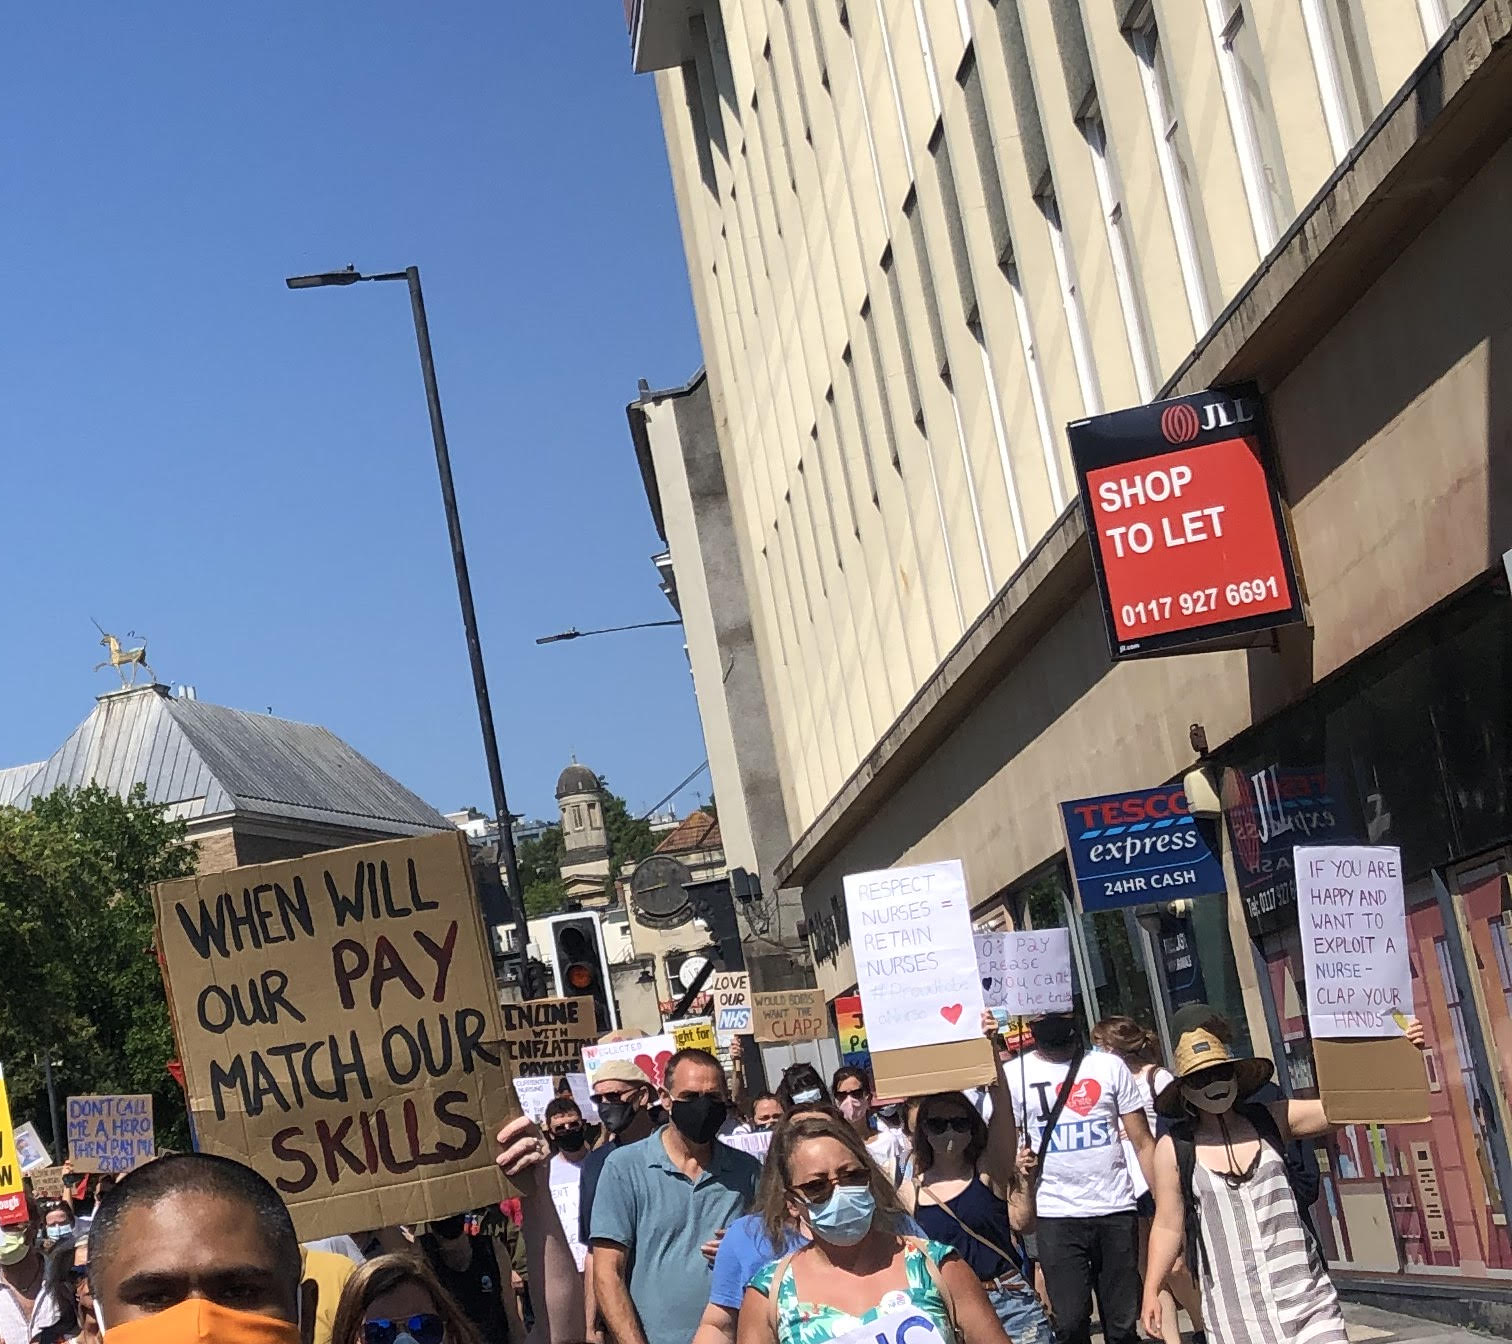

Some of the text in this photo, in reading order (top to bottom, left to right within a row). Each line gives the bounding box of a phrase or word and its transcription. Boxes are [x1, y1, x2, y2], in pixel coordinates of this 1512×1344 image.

[1202, 399, 1253, 430] JLL
[1099, 466, 1192, 512] SHOP
[1106, 506, 1225, 558] TO LET
[1122, 576, 1279, 627] 0117 927 6691
[1090, 831, 1197, 864] express
[1310, 860, 1396, 878] IF YOU ARE
[858, 874, 935, 901] RESPECT
[1104, 870, 1196, 895] 24HR CASH
[175, 858, 439, 959] WHEN WILL
[1311, 888, 1353, 906] HAPPY
[1360, 889, 1386, 906] AND
[861, 901, 930, 926] NURSES
[1311, 913, 1383, 929] WANT TO
[865, 926, 932, 952] RETAIN
[1314, 936, 1396, 954] EXPLOIT A
[866, 952, 938, 977] NURSES
[197, 920, 458, 1034] OUR PAY
[714, 975, 747, 990] LOVE
[720, 993, 744, 1005] OUR
[754, 994, 786, 1006] WOULD
[1317, 987, 1401, 1005] CLAP YOUR
[720, 1010, 748, 1028] NHS
[763, 1008, 812, 1019] WANT THE
[1334, 1011, 1383, 1028] HANDS
[532, 1028, 568, 1039] WITH
[696, 1027, 709, 1041] for
[772, 1018, 822, 1038] CLAP?
[210, 1008, 502, 1121] MATCH OUR
[116, 1098, 147, 1115] CALL
[1029, 1081, 1052, 1122] I
[68, 1118, 151, 1141] ME A HERO
[1046, 1119, 1107, 1151] NHS
[69, 1138, 108, 1160] THEN
[110, 1137, 133, 1156] PAY
[271, 1090, 482, 1194] SKILLS
